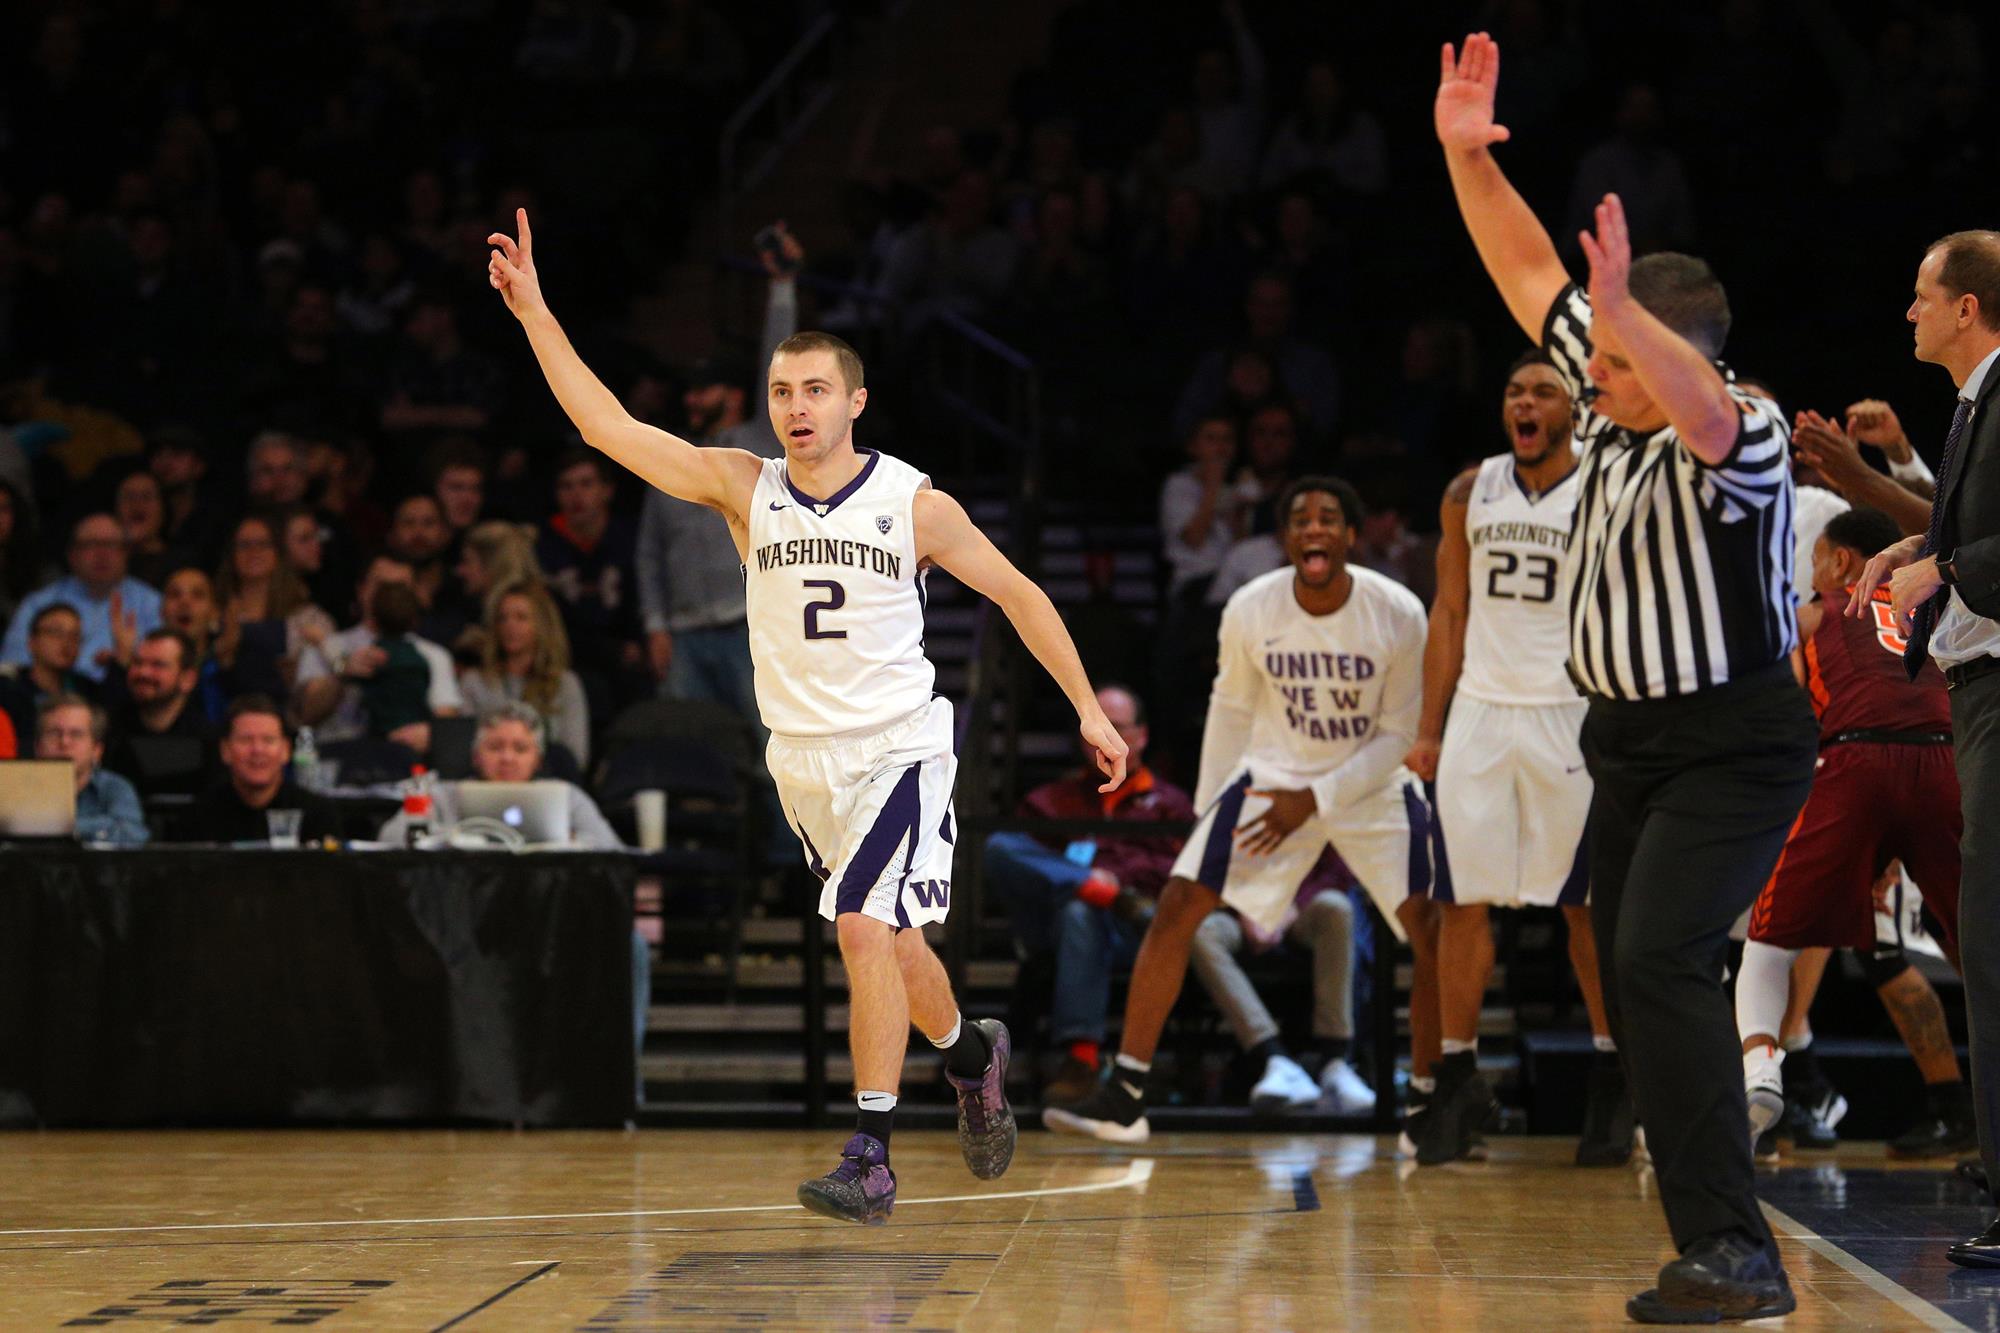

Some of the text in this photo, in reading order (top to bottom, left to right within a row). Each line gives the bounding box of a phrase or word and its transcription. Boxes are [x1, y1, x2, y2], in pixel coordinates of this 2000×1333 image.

[1473, 521, 1569, 553] WASHINGTO
[757, 538, 900, 580] WASHINGTON
[1488, 550, 1558, 603] 23
[803, 579, 847, 639] 2
[1266, 653, 1374, 680] UNITED
[1329, 688, 1361, 710] W
[909, 879, 950, 908] W
